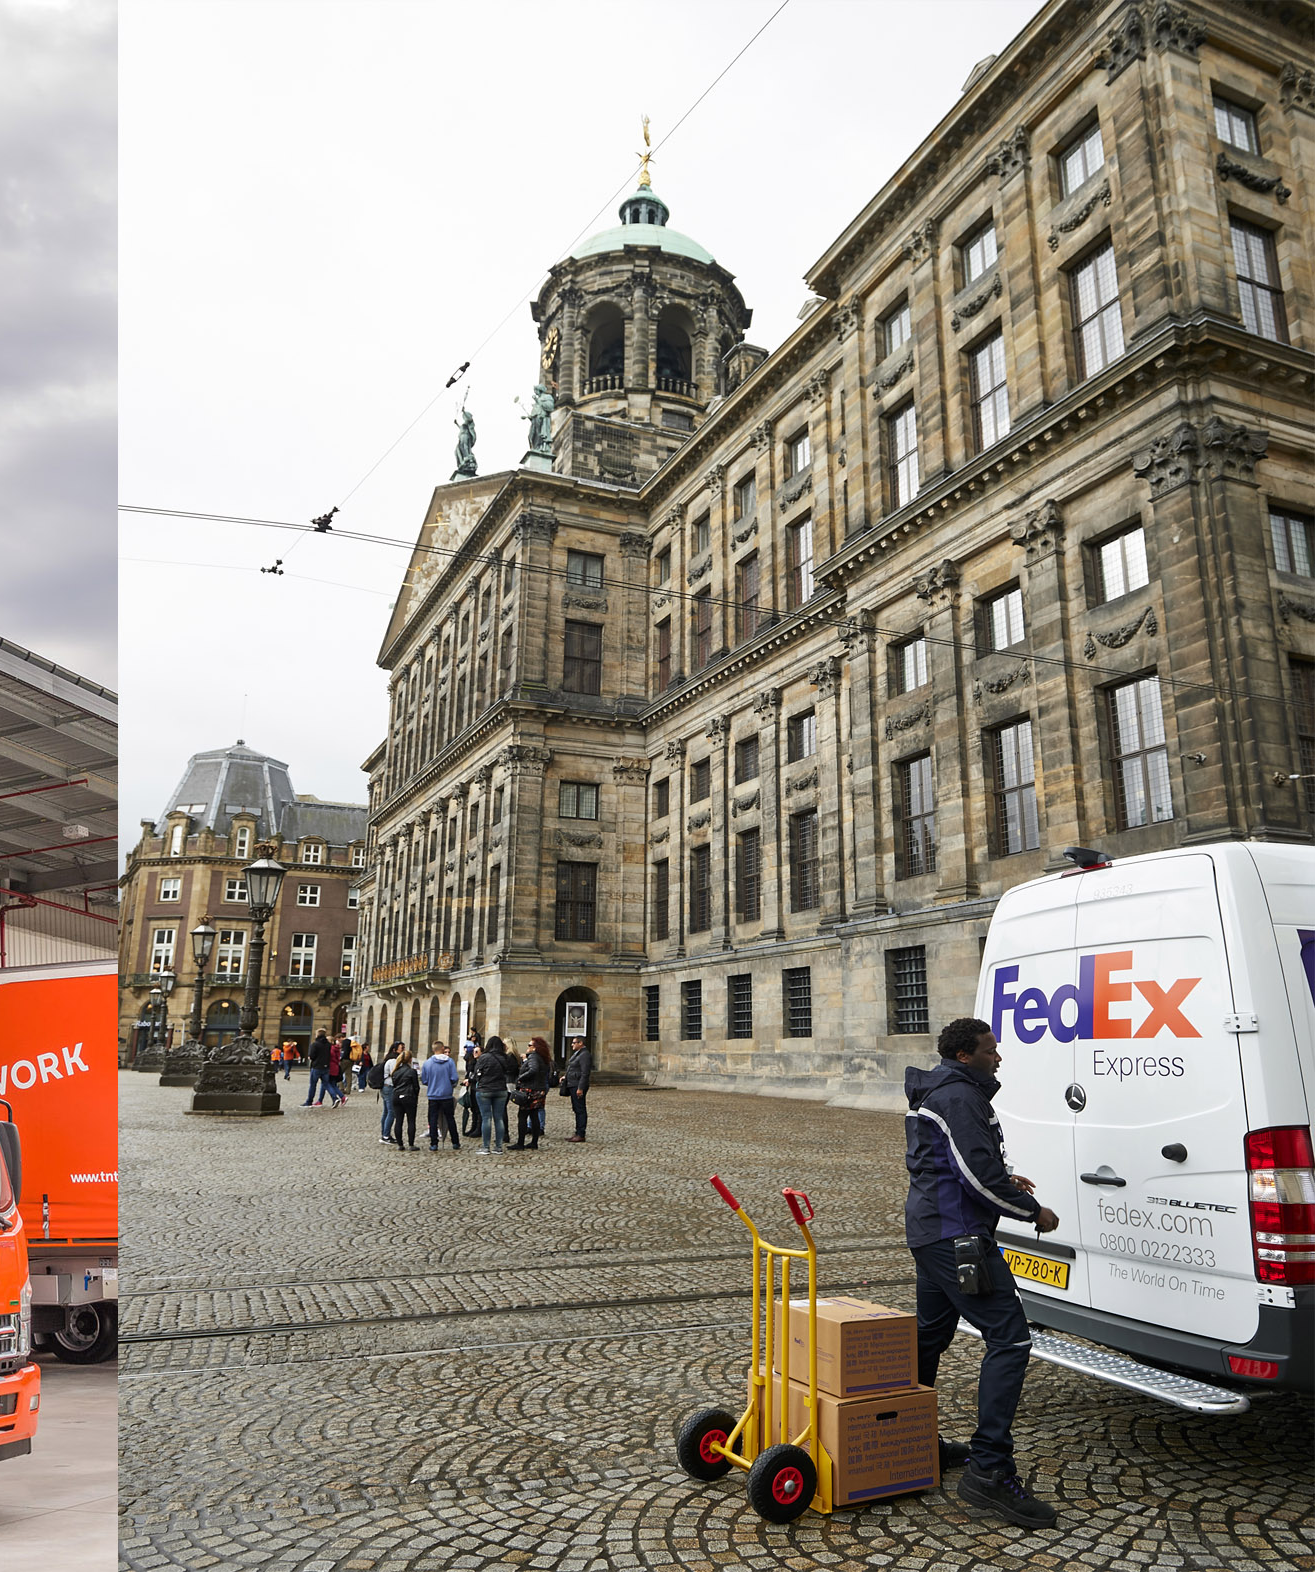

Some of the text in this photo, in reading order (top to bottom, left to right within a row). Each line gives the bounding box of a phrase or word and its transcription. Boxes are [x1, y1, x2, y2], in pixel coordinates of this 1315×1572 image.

[991, 950, 1203, 1044] FedEx
[1093, 1050, 1185, 1082] Express
[1097, 1198, 1214, 1237] fedex.com
[1146, 1196, 1238, 1214] 313 BLUETEC
[1099, 1232, 1216, 1268] 0800 0222333
[1108, 1263, 1225, 1301] The World On Time
